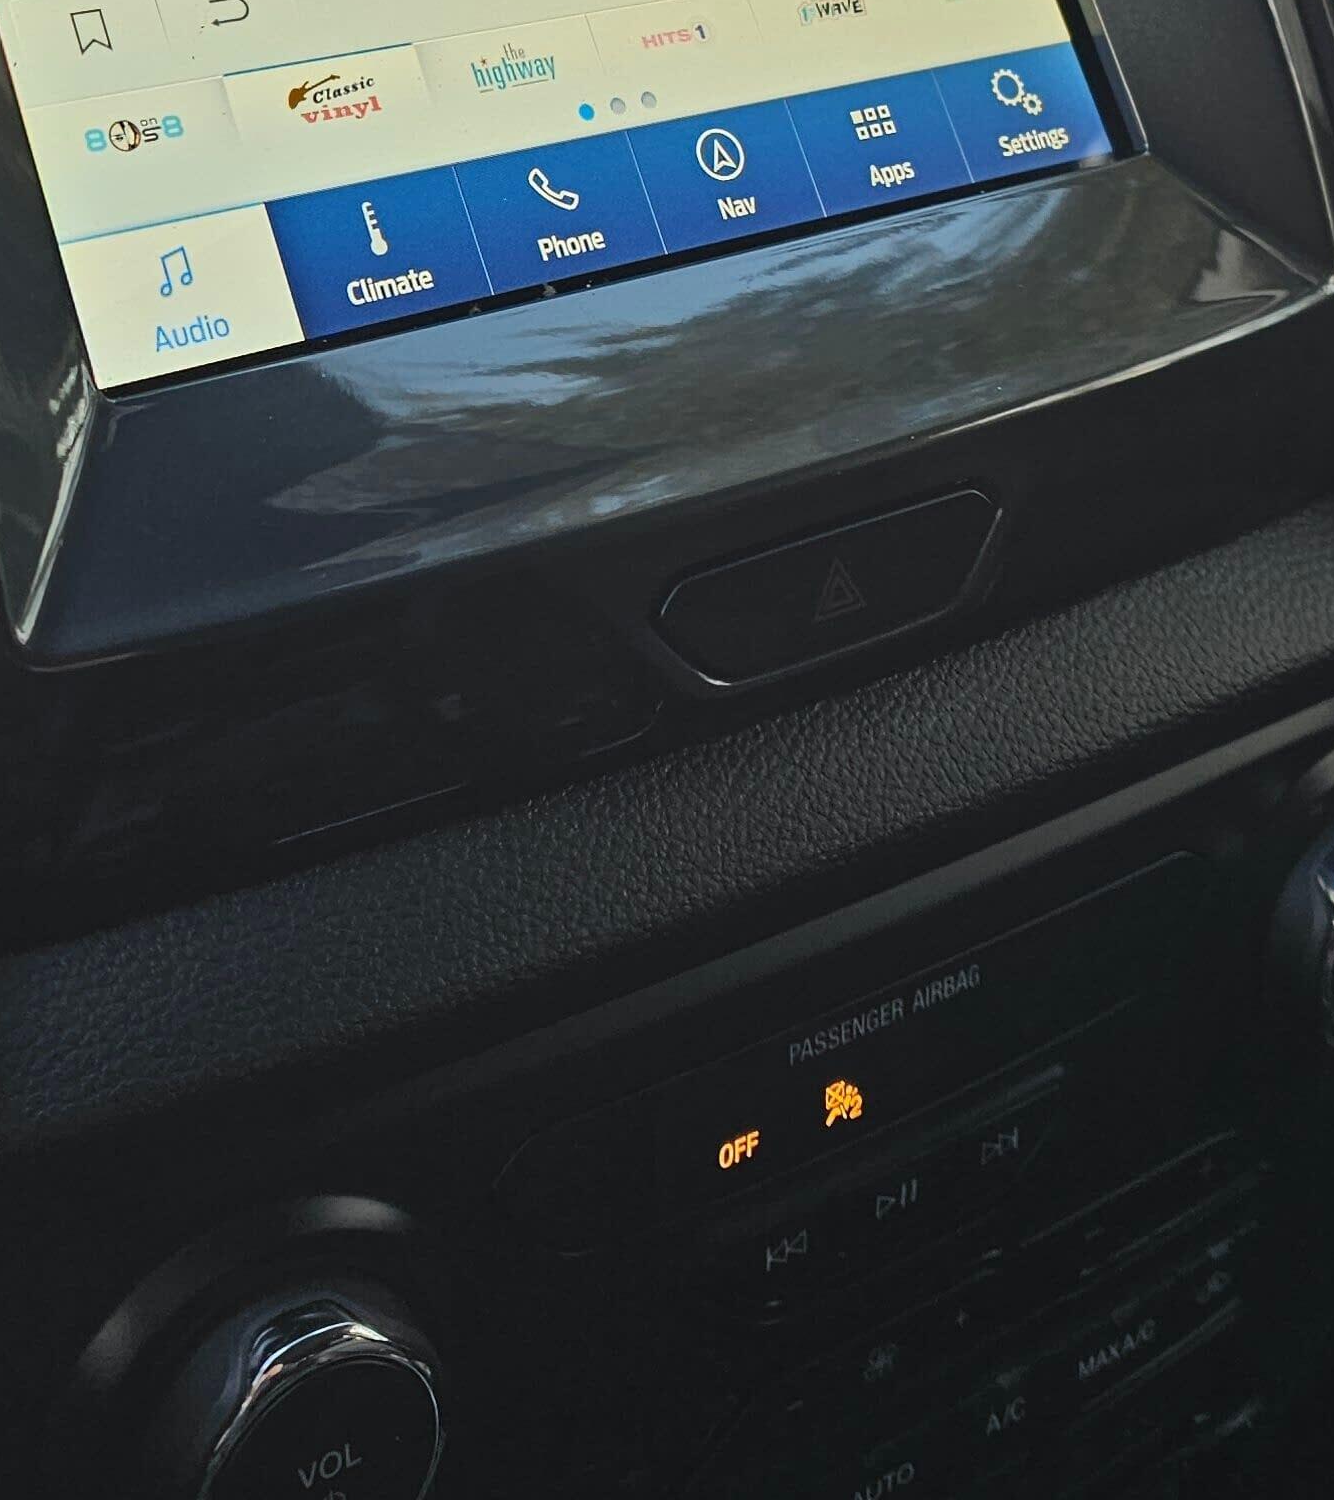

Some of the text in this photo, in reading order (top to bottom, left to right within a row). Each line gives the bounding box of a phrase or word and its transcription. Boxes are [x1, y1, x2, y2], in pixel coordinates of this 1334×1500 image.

[503, 43, 526, 60] the
[640, 28, 693, 49] HITS
[471, 55, 556, 90] highway
[312, 76, 376, 104] Classic
[300, 95, 383, 124] vinyl
[998, 126, 1069, 157] Settings
[870, 160, 915, 187] Apps
[717, 196, 756, 221] Nav
[538, 228, 606, 262] Phone
[346, 268, 435, 306] Climate
[155, 315, 231, 353] Audio
[789, 963, 981, 1066] PASSENGER AIRBAG
[718, 1129, 760, 1170] OFF
[986, 1396, 1027, 1435] A/C
[297, 1443, 363, 1489] VOL
